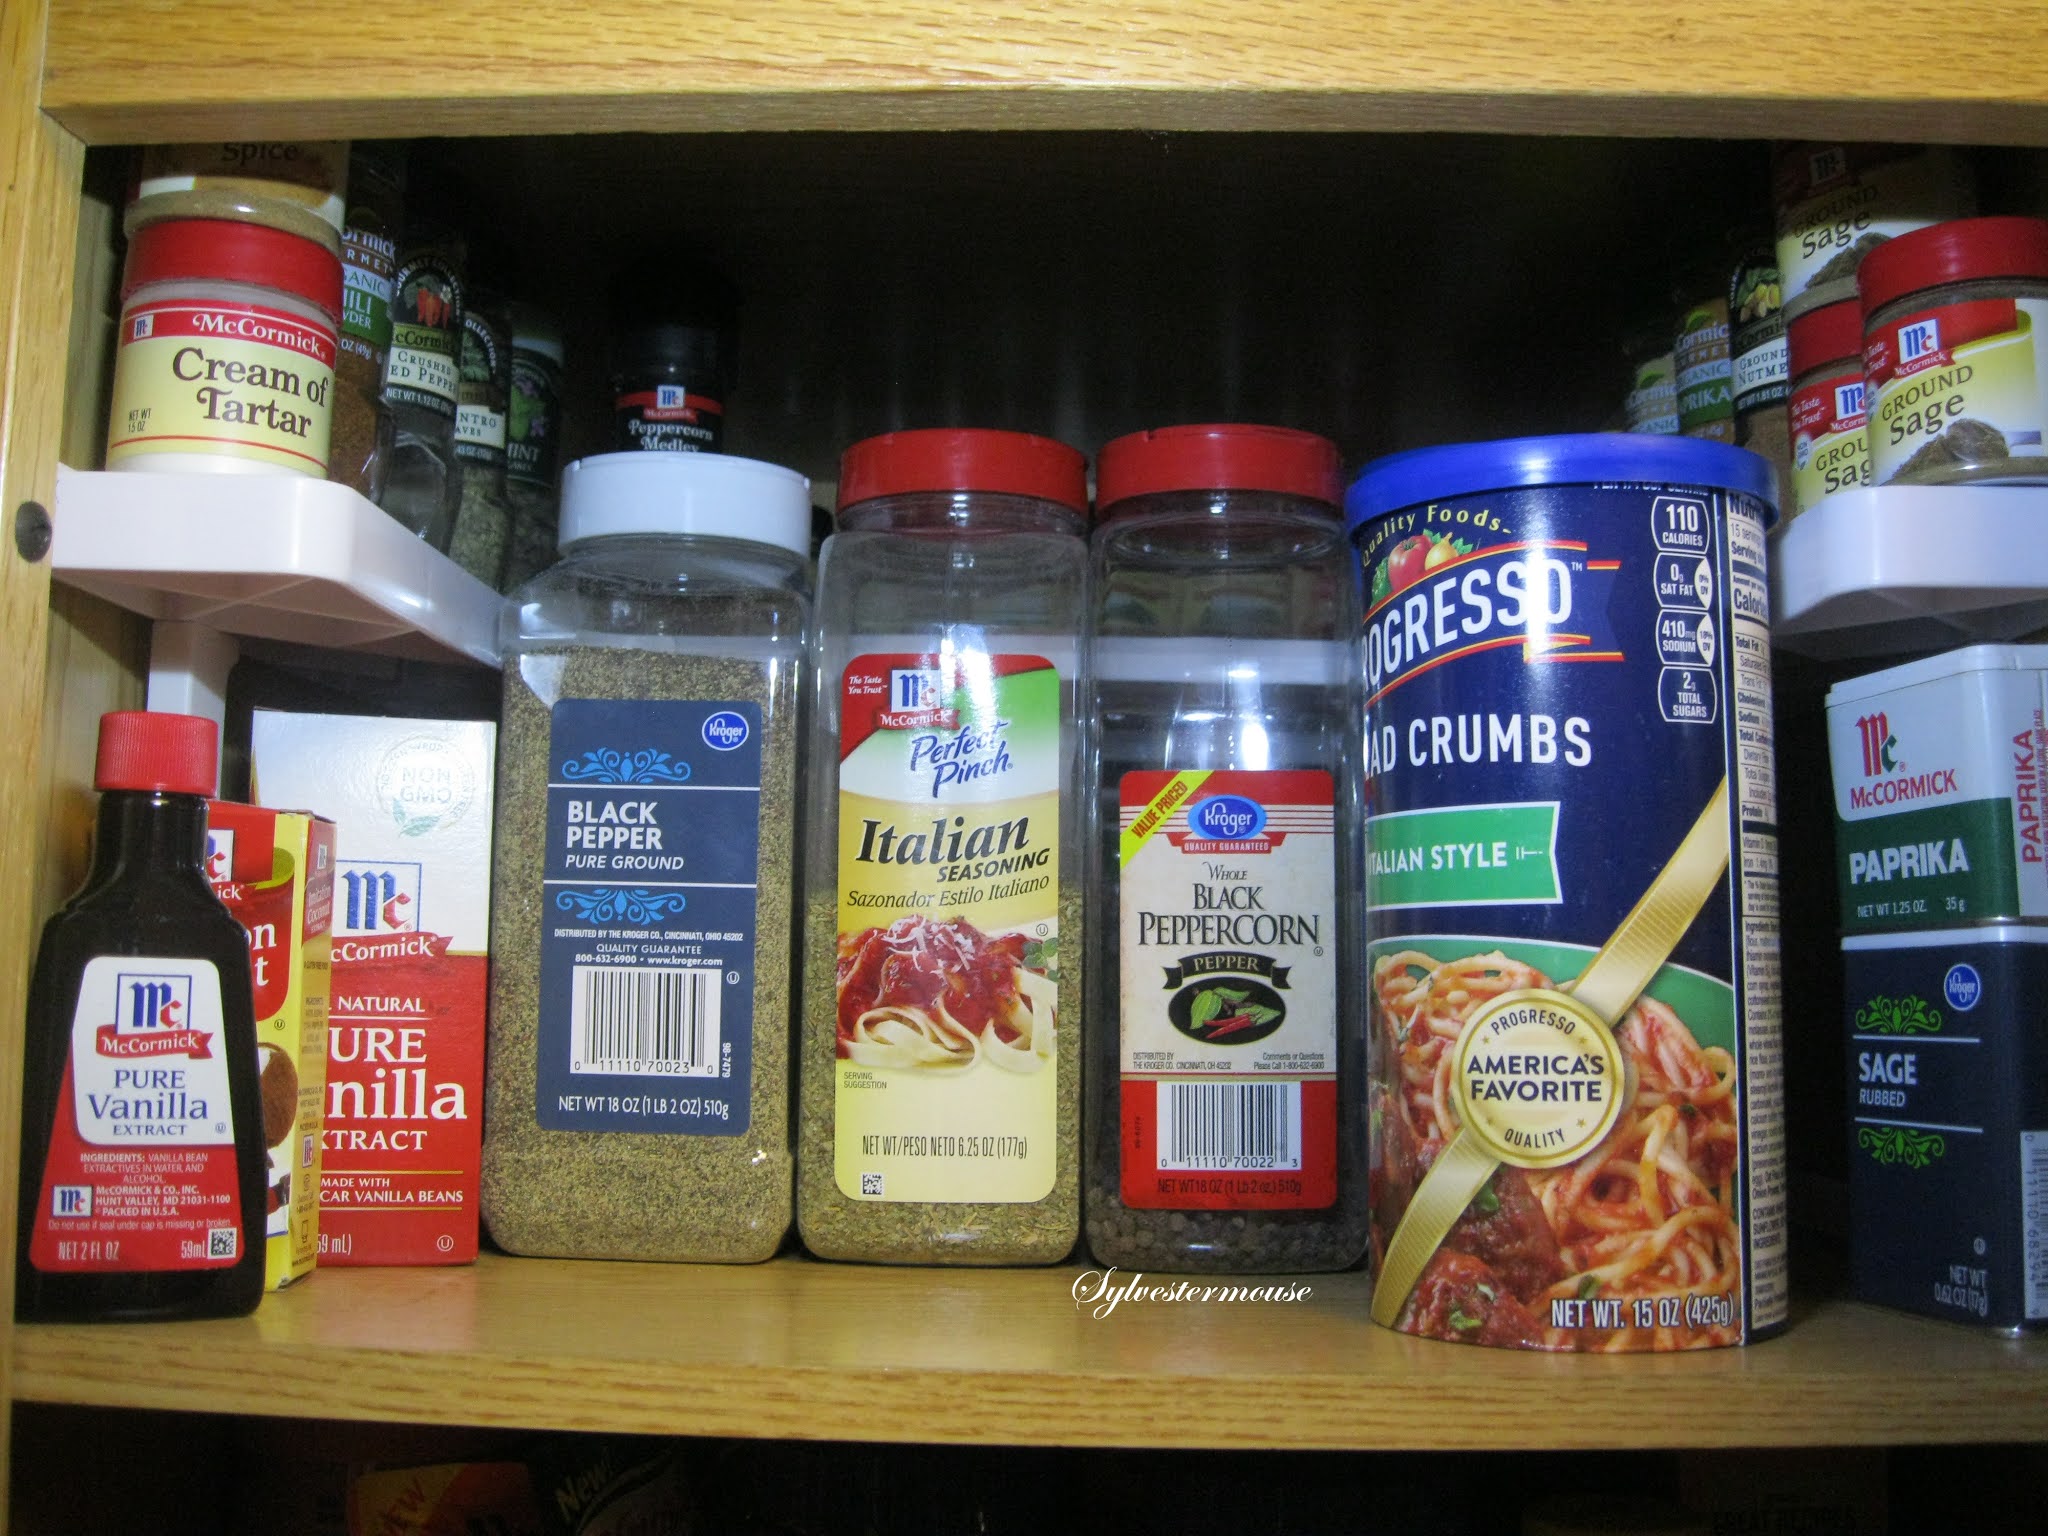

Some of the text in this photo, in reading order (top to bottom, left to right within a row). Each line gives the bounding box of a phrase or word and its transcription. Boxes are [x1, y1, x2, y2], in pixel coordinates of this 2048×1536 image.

[1802, 210, 1871, 259] Sage
[193, 313, 321, 355] McCormick
[390, 364, 410, 378] ED
[1738, 362, 1788, 387] NUTME
[1895, 352, 1947, 376] McCormick
[172, 347, 328, 407] Cream of
[1882, 365, 1973, 421] GROUND
[128, 408, 152, 421] NET WT
[196, 386, 312, 438] Tartar
[459, 412, 497, 428] NTRO
[1890, 394, 1964, 446] Sage
[455, 426, 482, 437] AVES
[628, 419, 713, 440] Peppercorn
[1830, 417, 1867, 431] McCorm
[1824, 459, 1870, 495] Sag
[1666, 504, 1698, 532] 110
[1364, 512, 1416, 567] Quality
[1662, 532, 1703, 546] CALORIES
[1661, 583, 1694, 596] SAT FAT
[1364, 558, 1572, 692] OGRESSO
[1662, 640, 1696, 653] SODIUM
[848, 676, 882, 685] The Taste
[848, 686, 862, 695] You
[1678, 692, 1702, 705] TOTAL
[1673, 705, 1707, 718] SUGARS
[709, 718, 743, 744] Kroger
[1408, 713, 1592, 767] CRUMBS
[910, 720, 1008, 772] Perfect
[402, 767, 450, 782] NON
[933, 741, 1009, 798] Pinch
[400, 786, 451, 803] GMO
[1850, 769, 1958, 810] McCORMICK
[2013, 729, 2043, 863] PAPRIKA
[568, 801, 658, 824] BLACK
[1131, 780, 1188, 839] VALUE PRICED
[1204, 802, 1253, 835] Kroger
[566, 826, 663, 850] PEPPER
[856, 816, 1029, 865] Italian
[1184, 842, 1270, 851] QUALITY GUARANTEED
[565, 855, 684, 870] PURE GROUND
[936, 847, 1050, 883] SEASONING
[1431, 841, 1507, 870] STYLE
[1849, 838, 1971, 885] PAPRIKA
[847, 875, 1050, 908] Sazonador Estilo Italiano
[1193, 883, 1266, 910] BLACK
[1857, 904, 1874, 918] NET
[1876, 903, 1890, 916] WT
[1892, 901, 1911, 915] 1.25
[1137, 911, 1320, 946] PEPPERCORN
[330, 936, 434, 962] cCormick
[575, 954, 723, 967] 800-632-6900 www.kroger.com
[597, 944, 702, 955] QUALITY GUARANTEE
[1193, 955, 1259, 971] PEPPER
[1949, 972, 1976, 1003] Kroger
[338, 996, 426, 1013] NATURAL
[1491, 1009, 1576, 1035] PROGRESSO
[102, 1034, 199, 1054] McCormick
[329, 1027, 427, 1063] URE
[722, 1042, 731, 1077] 98-7479
[1467, 1054, 1604, 1075] AMERICA'S
[1858, 1053, 1918, 1085] SAGE
[114, 1070, 186, 1089] PURE
[844, 1072, 873, 1080] SERVING
[844, 1081, 887, 1089] SUGGESTION
[328, 1067, 468, 1120] nilla
[1471, 1080, 1601, 1101] FAVORITE
[1859, 1088, 1906, 1108] RUBBED
[87, 1092, 208, 1120] Vanilla
[559, 1096, 582, 1111] NET
[585, 1097, 605, 1112] WT
[608, 1098, 619, 1112] 18
[622, 1098, 640, 1113] OZ
[654, 1098, 667, 1113] LB
[670, 1099, 677, 1114] 2
[680, 1097, 701, 1118] OZ)
[704, 1099, 729, 1120] 510g
[113, 1125, 187, 1136] EXTRACT
[1504, 1128, 1565, 1149] QUALITY
[81, 1153, 208, 1163] INGREDIENTS: VANILLA BEAN
[862, 1135, 1028, 1160] NET WT/PESO NETO 6.25 OZ (177g)
[84, 1164, 140, 1174] EXTRACTIVES
[143, 1164, 151, 1173] IN
[185, 1163, 204, 1173] AND
[124, 1175, 166, 1184] ALCOHOL.
[97, 1185, 151, 1195] McCORMICK
[154, 1185, 161, 1195] &
[182, 1185, 199, 1195] INC.
[321, 1178, 390, 1187] MADE WITH
[96, 1196, 121, 1206] HUNT
[163, 1196, 178, 1205] MD
[181, 1195, 230, 1205] 21031-1100
[355, 1191, 414, 1203] VANILLA
[419, 1191, 463, 1203] BEANS
[103, 1206, 179, 1216] PACKED IN U.S.A.
[59, 1241, 77, 1260] NET
[81, 1242, 87, 1260] 2
[91, 1242, 101, 1260] FL
[106, 1241, 120, 1260] OZ
[1949, 1265, 1988, 1289] NET WT
[1552, 1292, 1733, 1329] NET WT. 15 OZ (425g)
